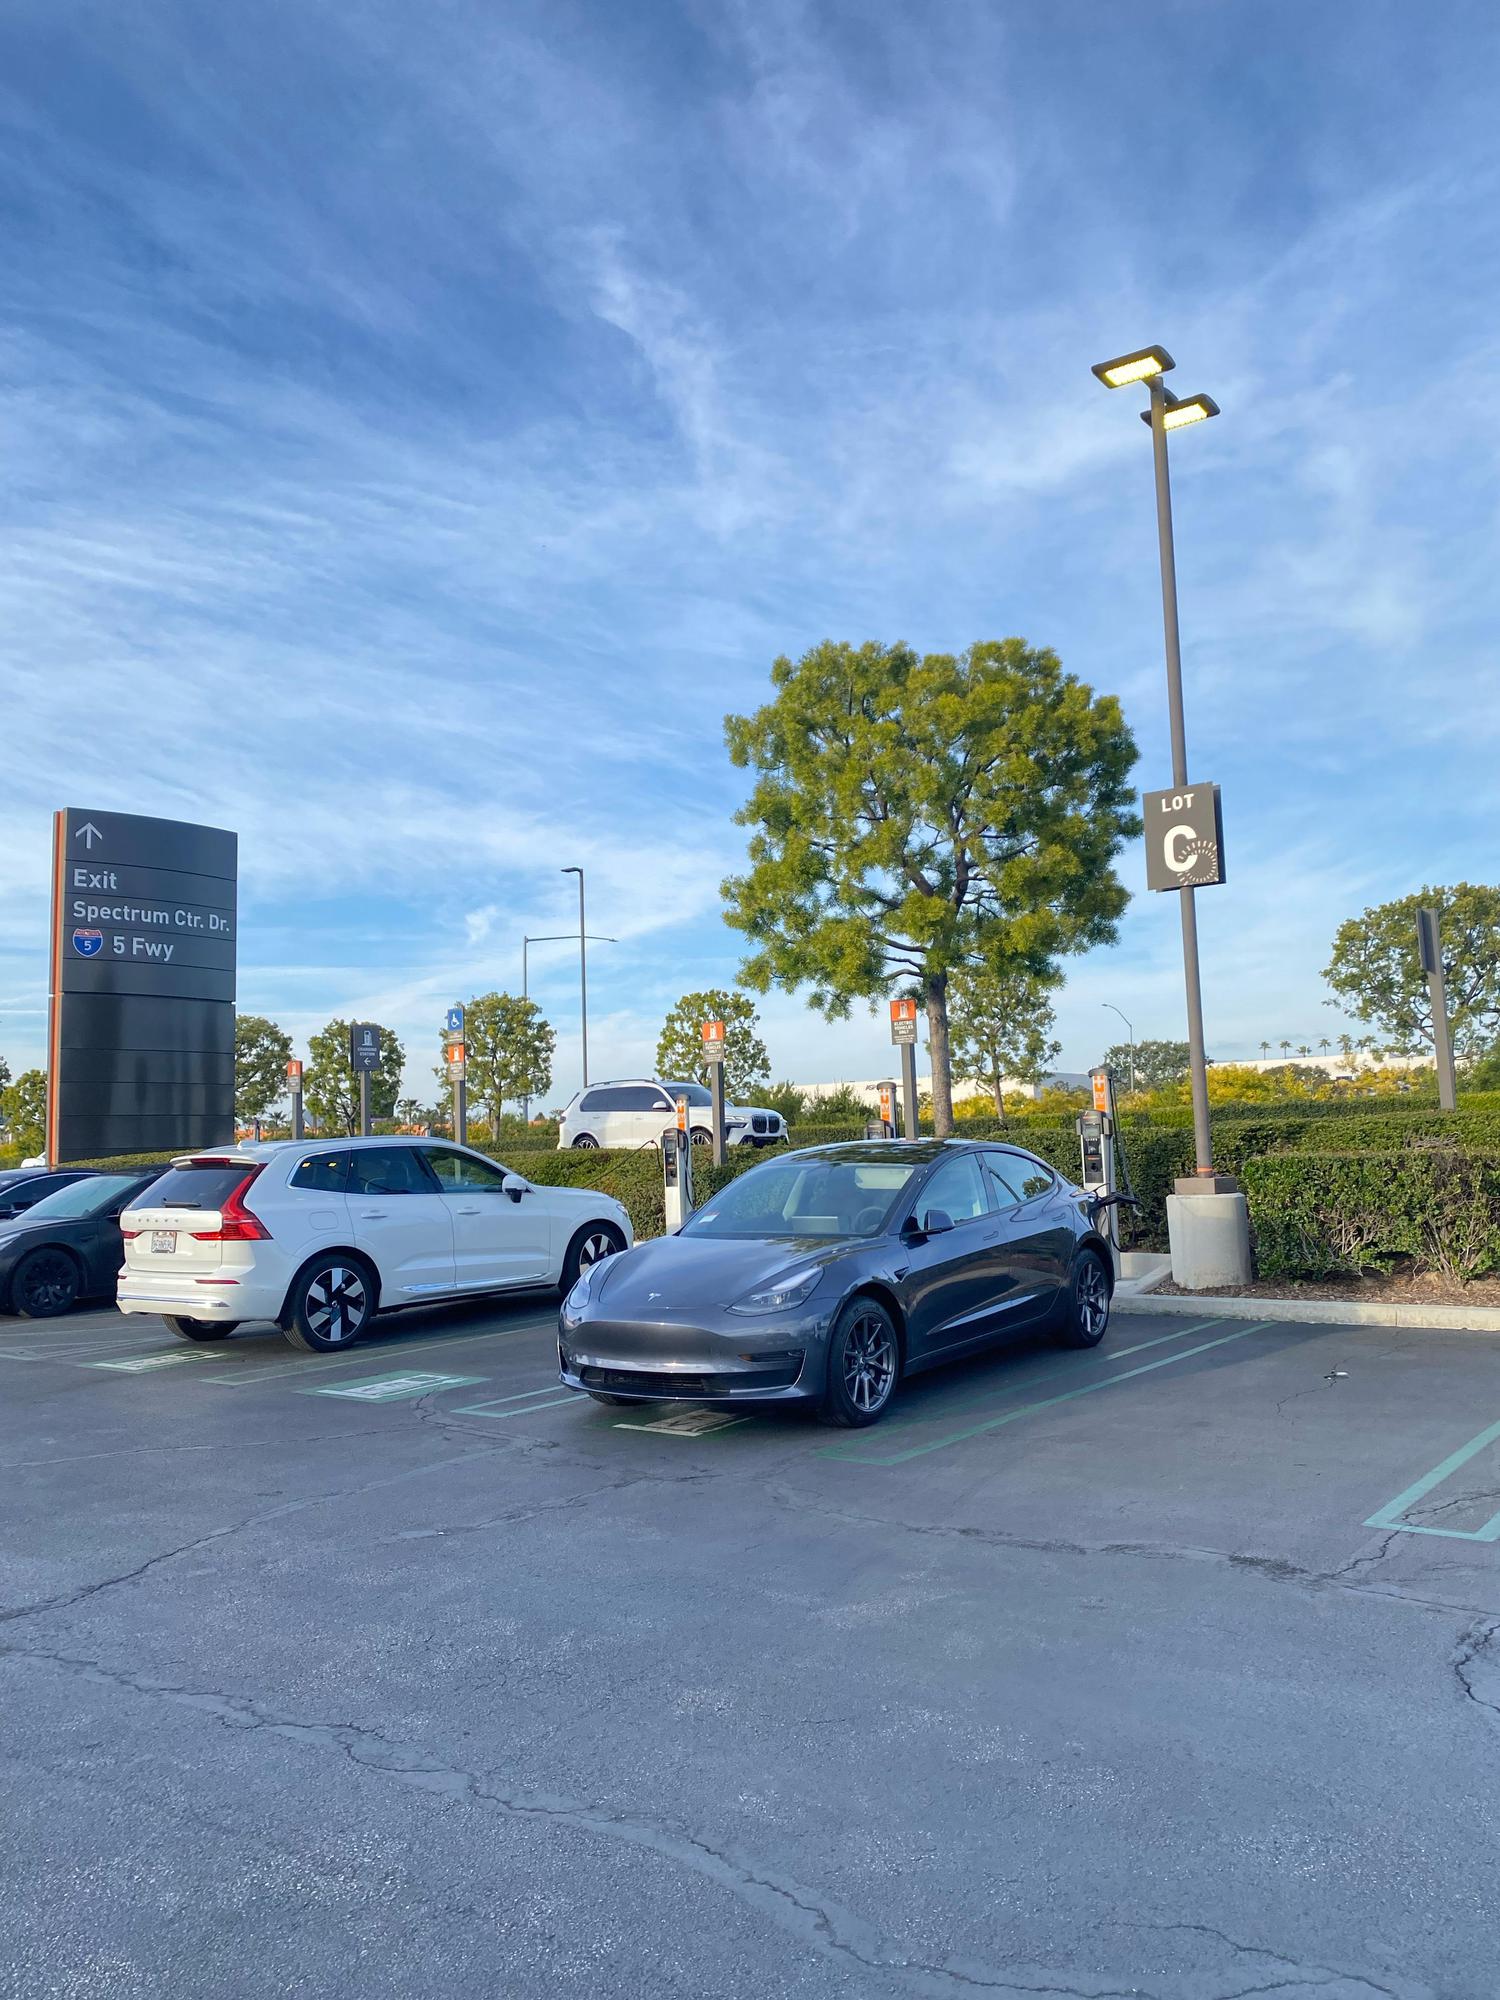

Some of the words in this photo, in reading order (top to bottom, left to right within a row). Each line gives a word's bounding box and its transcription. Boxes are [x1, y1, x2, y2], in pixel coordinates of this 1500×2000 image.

[1161, 793, 1195, 812] LOT
[1163, 824, 1198, 872] C
[73, 868, 117, 889] Exit
[72, 900, 169, 924] Spectrum
[174, 909, 204, 928] Ctr.
[209, 914, 230, 931] Dr.
[84, 940, 92, 951] 5
[113, 936, 125, 954] 5
[132, 937, 174, 961] Fwy
